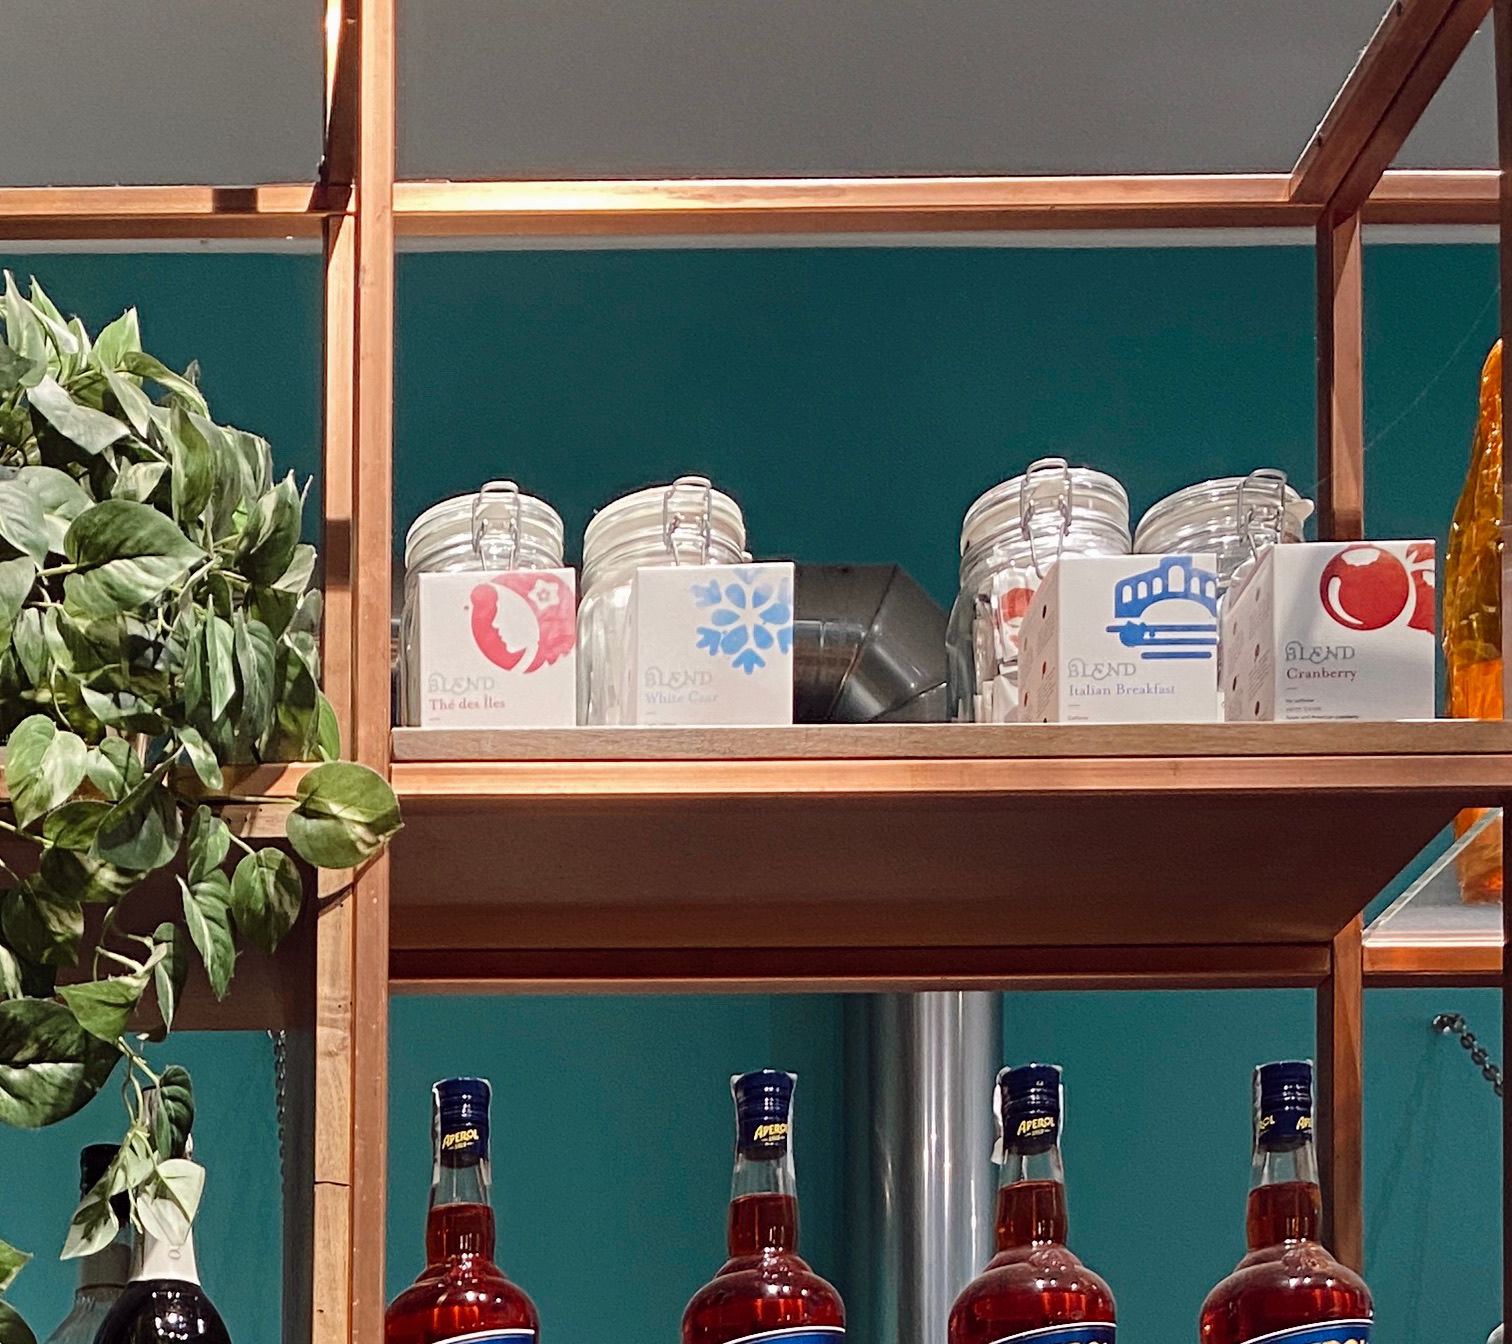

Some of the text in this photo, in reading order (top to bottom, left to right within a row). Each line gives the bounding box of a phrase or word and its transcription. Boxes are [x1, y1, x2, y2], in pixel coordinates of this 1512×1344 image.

[1284, 640, 1356, 664] BLEND
[644, 666, 713, 690] BLEND
[1067, 658, 1136, 681] BLEND
[1285, 665, 1358, 682] Cranberry
[427, 672, 495, 693] BLEND
[1068, 682, 1176, 696] Italian Breakfast
[459, 696, 479, 710] des
[1017, 1115, 1056, 1135] APEROL
[442, 1127, 479, 1150] APEROL
